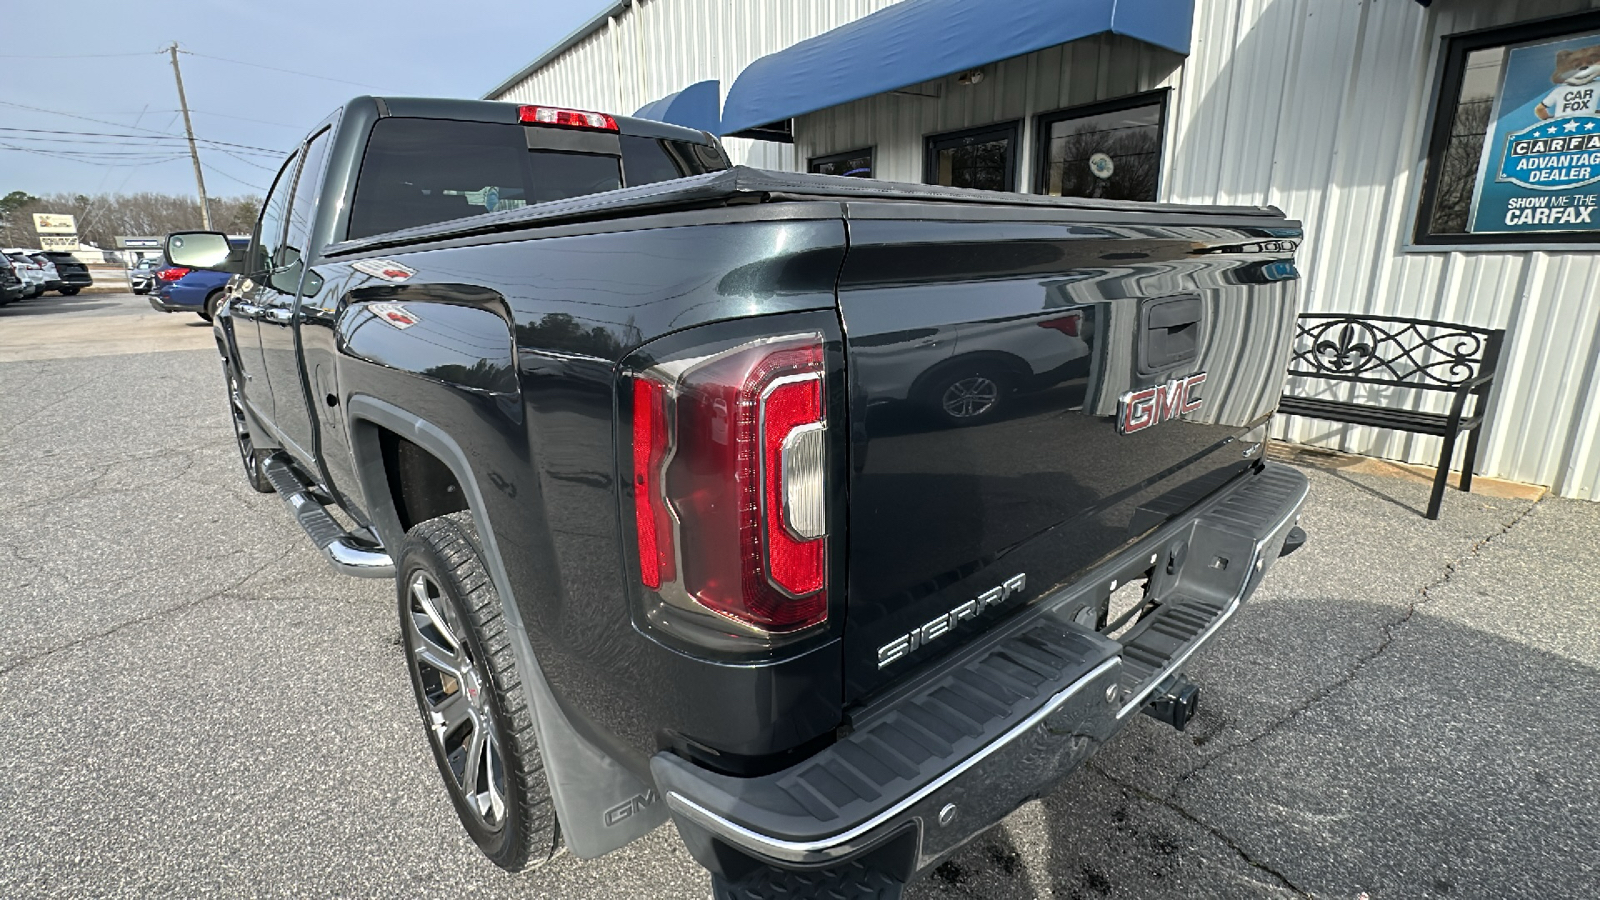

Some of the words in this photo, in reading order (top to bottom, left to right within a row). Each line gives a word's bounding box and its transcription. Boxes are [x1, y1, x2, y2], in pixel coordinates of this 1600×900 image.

[1564, 89, 1594, 102] CAR
[1562, 100, 1590, 113] FOX
[1529, 168, 1591, 182] DEALER
[1508, 196, 1548, 209] SHOW
[1550, 195, 1570, 207] ME
[1573, 194, 1598, 206] THE
[1505, 206, 1598, 226] CARFAX
[1118, 371, 1207, 434] GMC
[877, 572, 1026, 670] SIERRA
